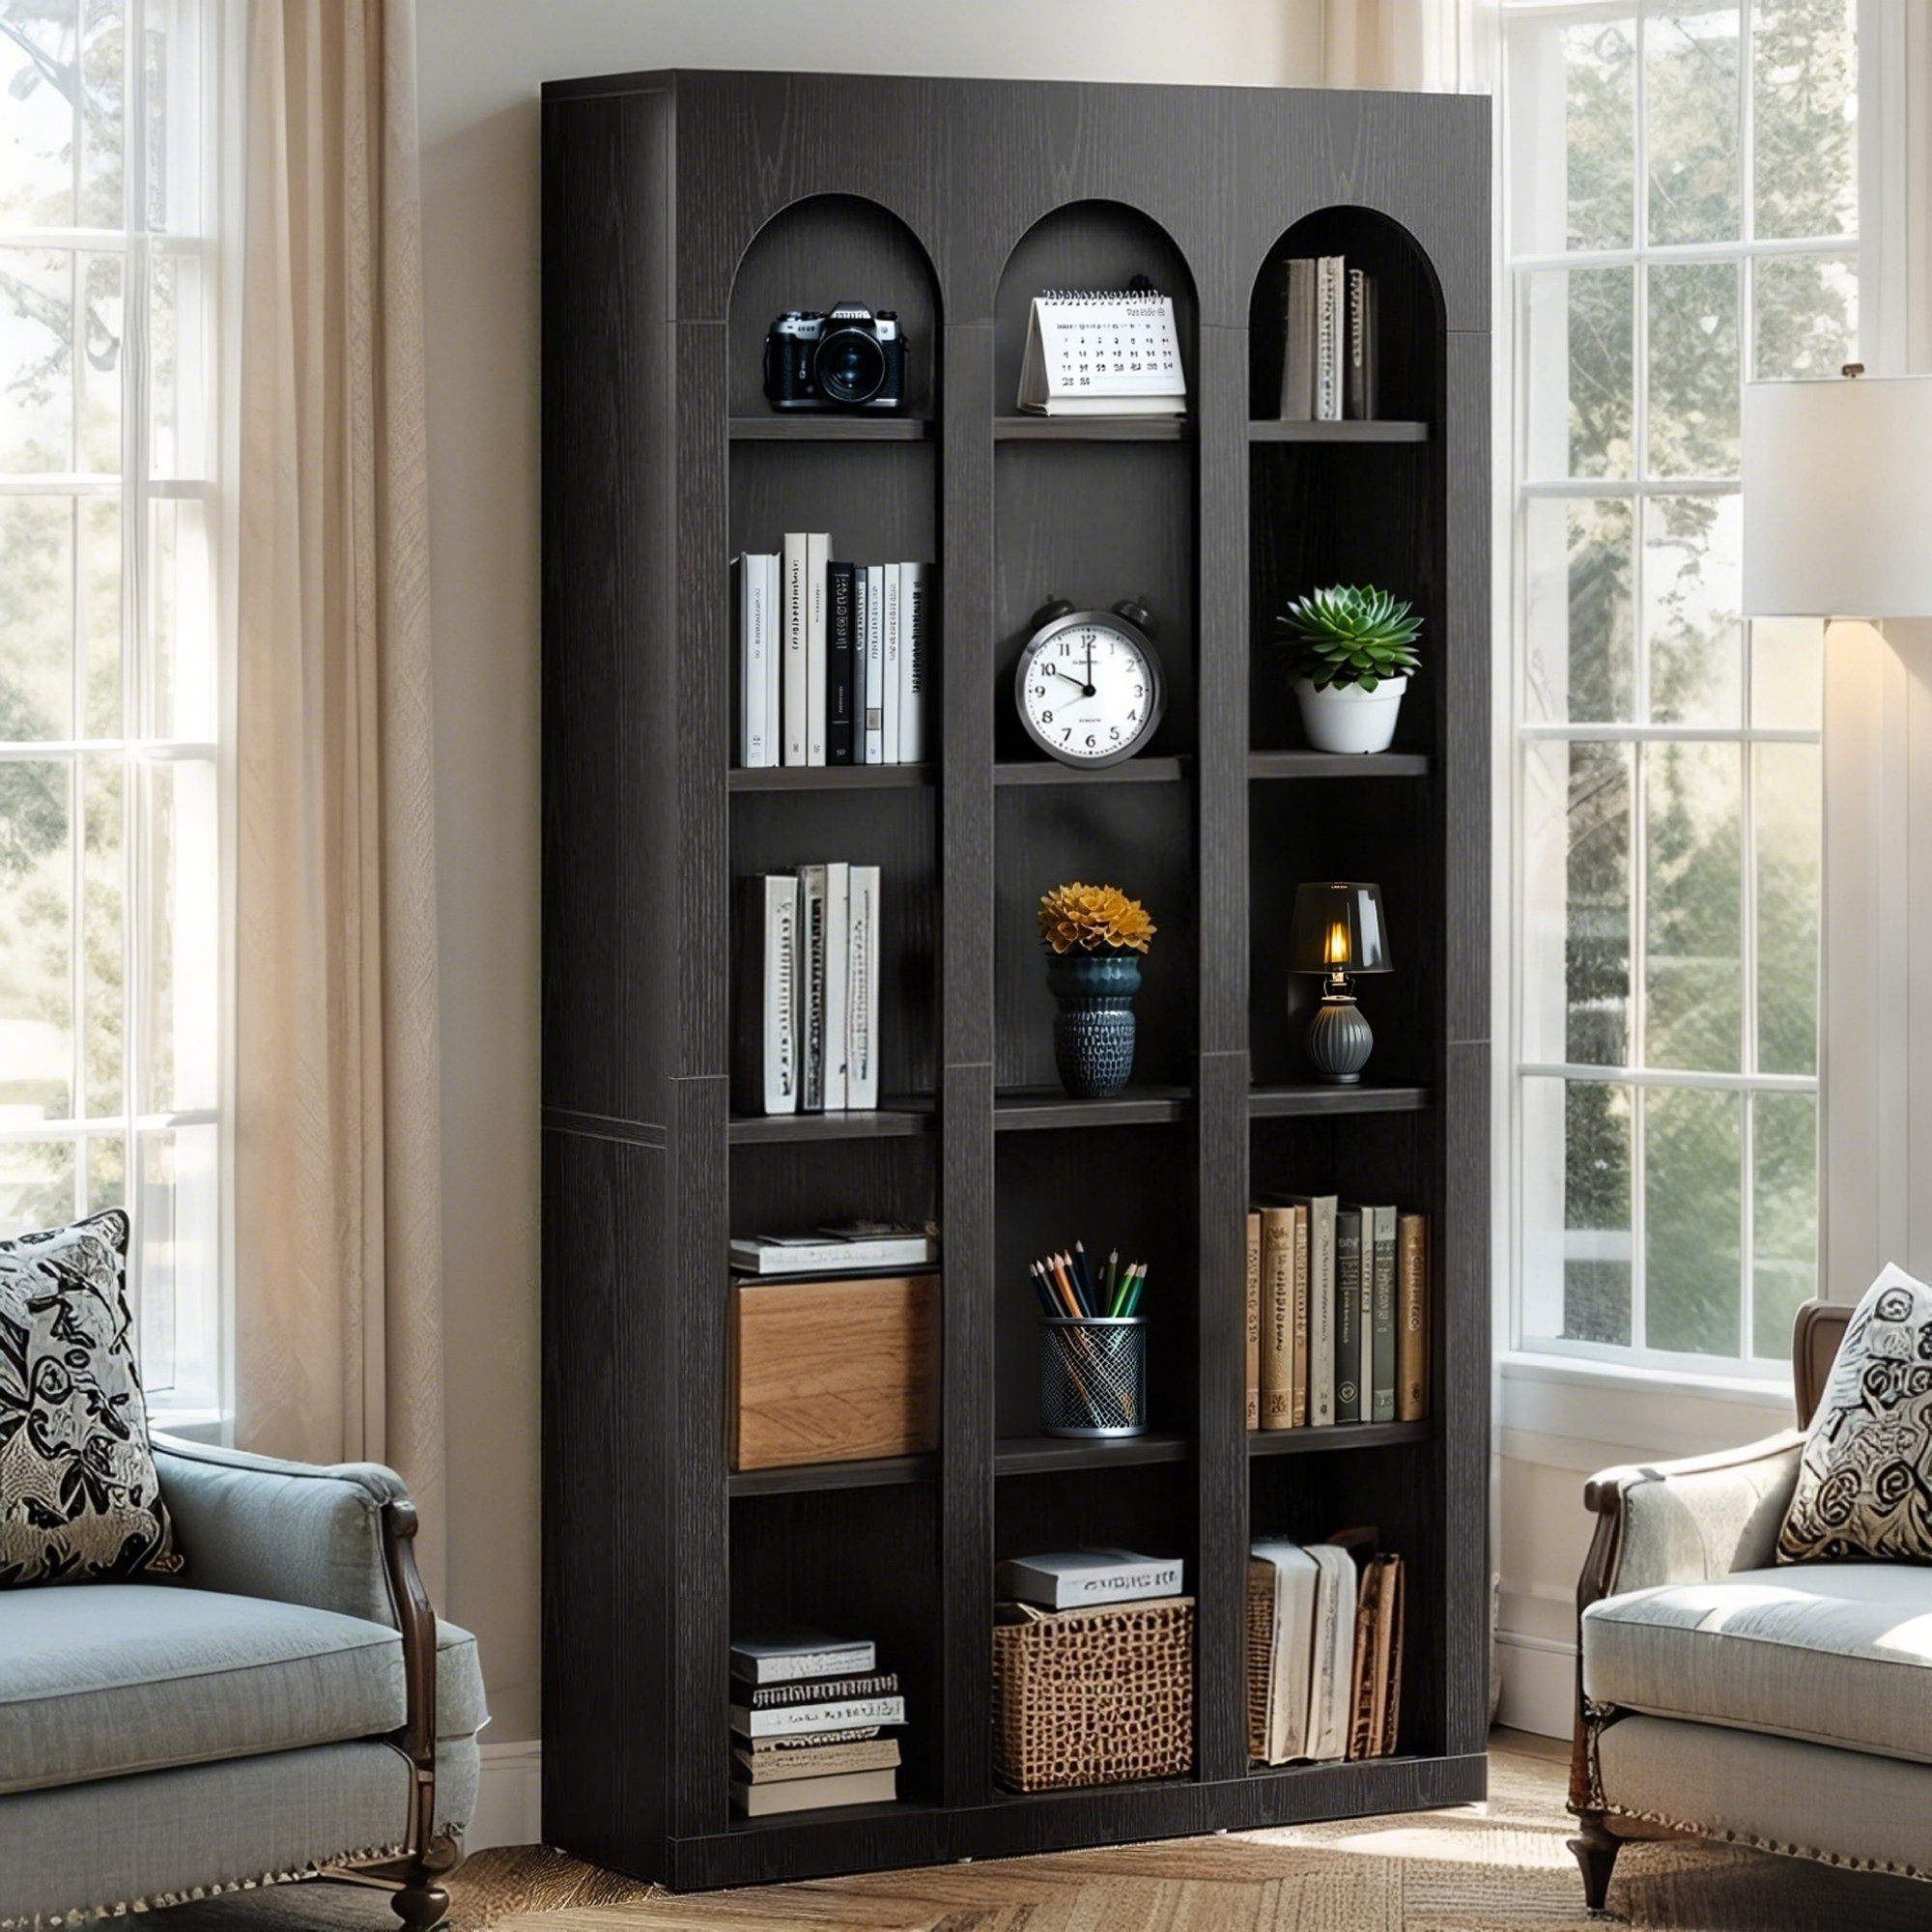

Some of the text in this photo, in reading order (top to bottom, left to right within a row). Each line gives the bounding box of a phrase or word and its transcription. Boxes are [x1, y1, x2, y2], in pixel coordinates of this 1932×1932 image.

[1080, 635, 1096, 648] 12
[1059, 643, 1070, 656] 11
[1110, 643, 1115, 655] 1
[1040, 663, 1056, 676] 10
[1125, 659, 1135, 672] 2
[1035, 686, 1045, 697] 9
[1133, 685, 1143, 697] 3
[1041, 710, 1053, 724] 8
[1126, 709, 1137, 721] 4
[1062, 727, 1072, 741] 7
[1110, 726, 1120, 740] 5
[1086, 734, 1096, 748] 6
